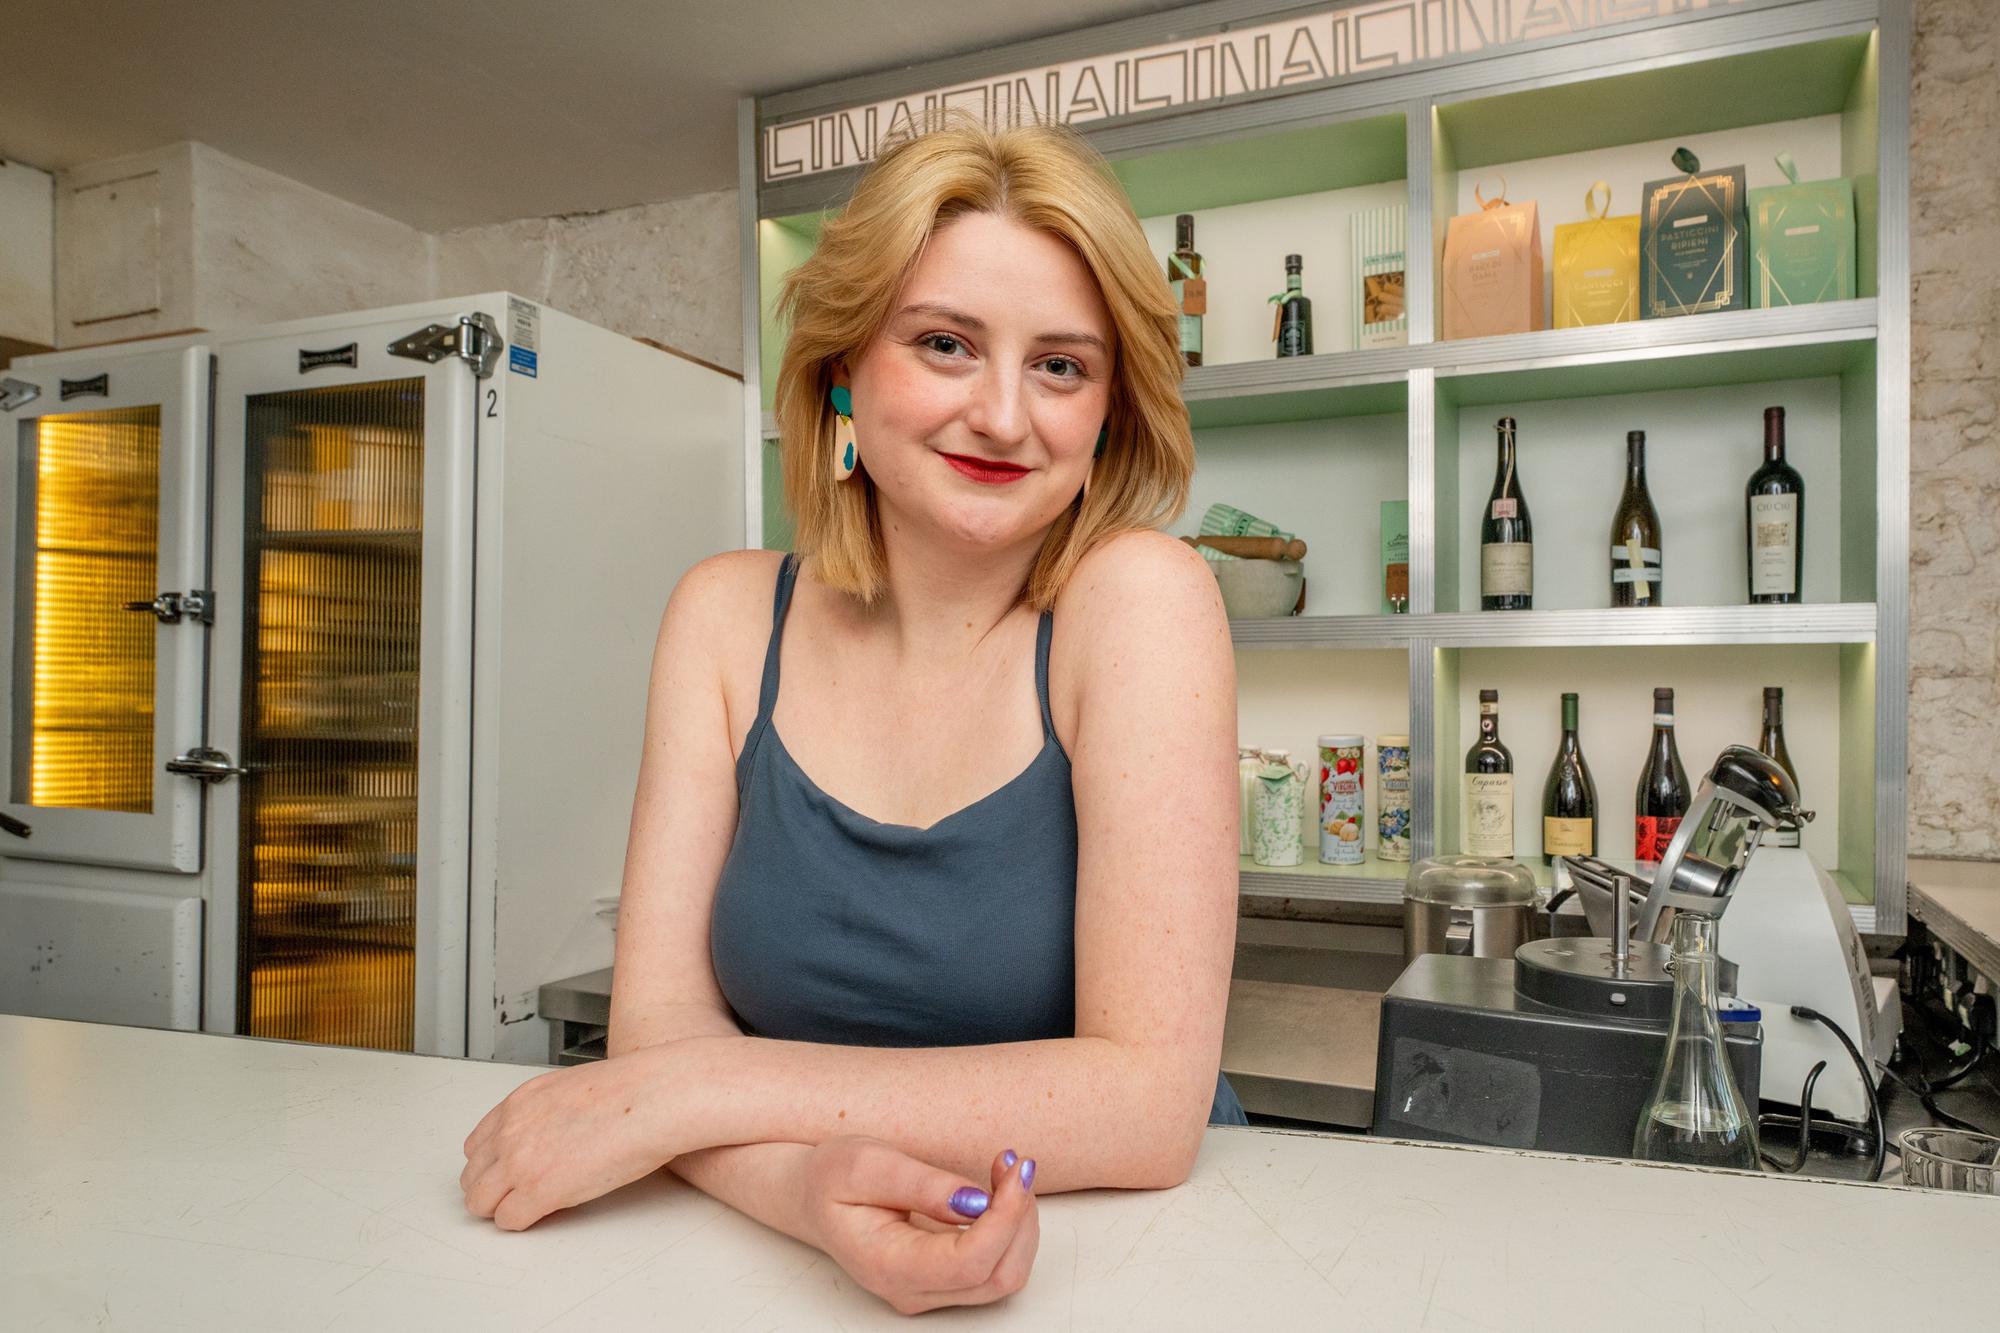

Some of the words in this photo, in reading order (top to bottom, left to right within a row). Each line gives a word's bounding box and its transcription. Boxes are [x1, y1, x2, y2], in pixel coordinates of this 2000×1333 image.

[1661, 224, 1720, 241] PASTICCINI
[1671, 237, 1709, 251] RIPIENI
[486, 389, 498, 418] 2
